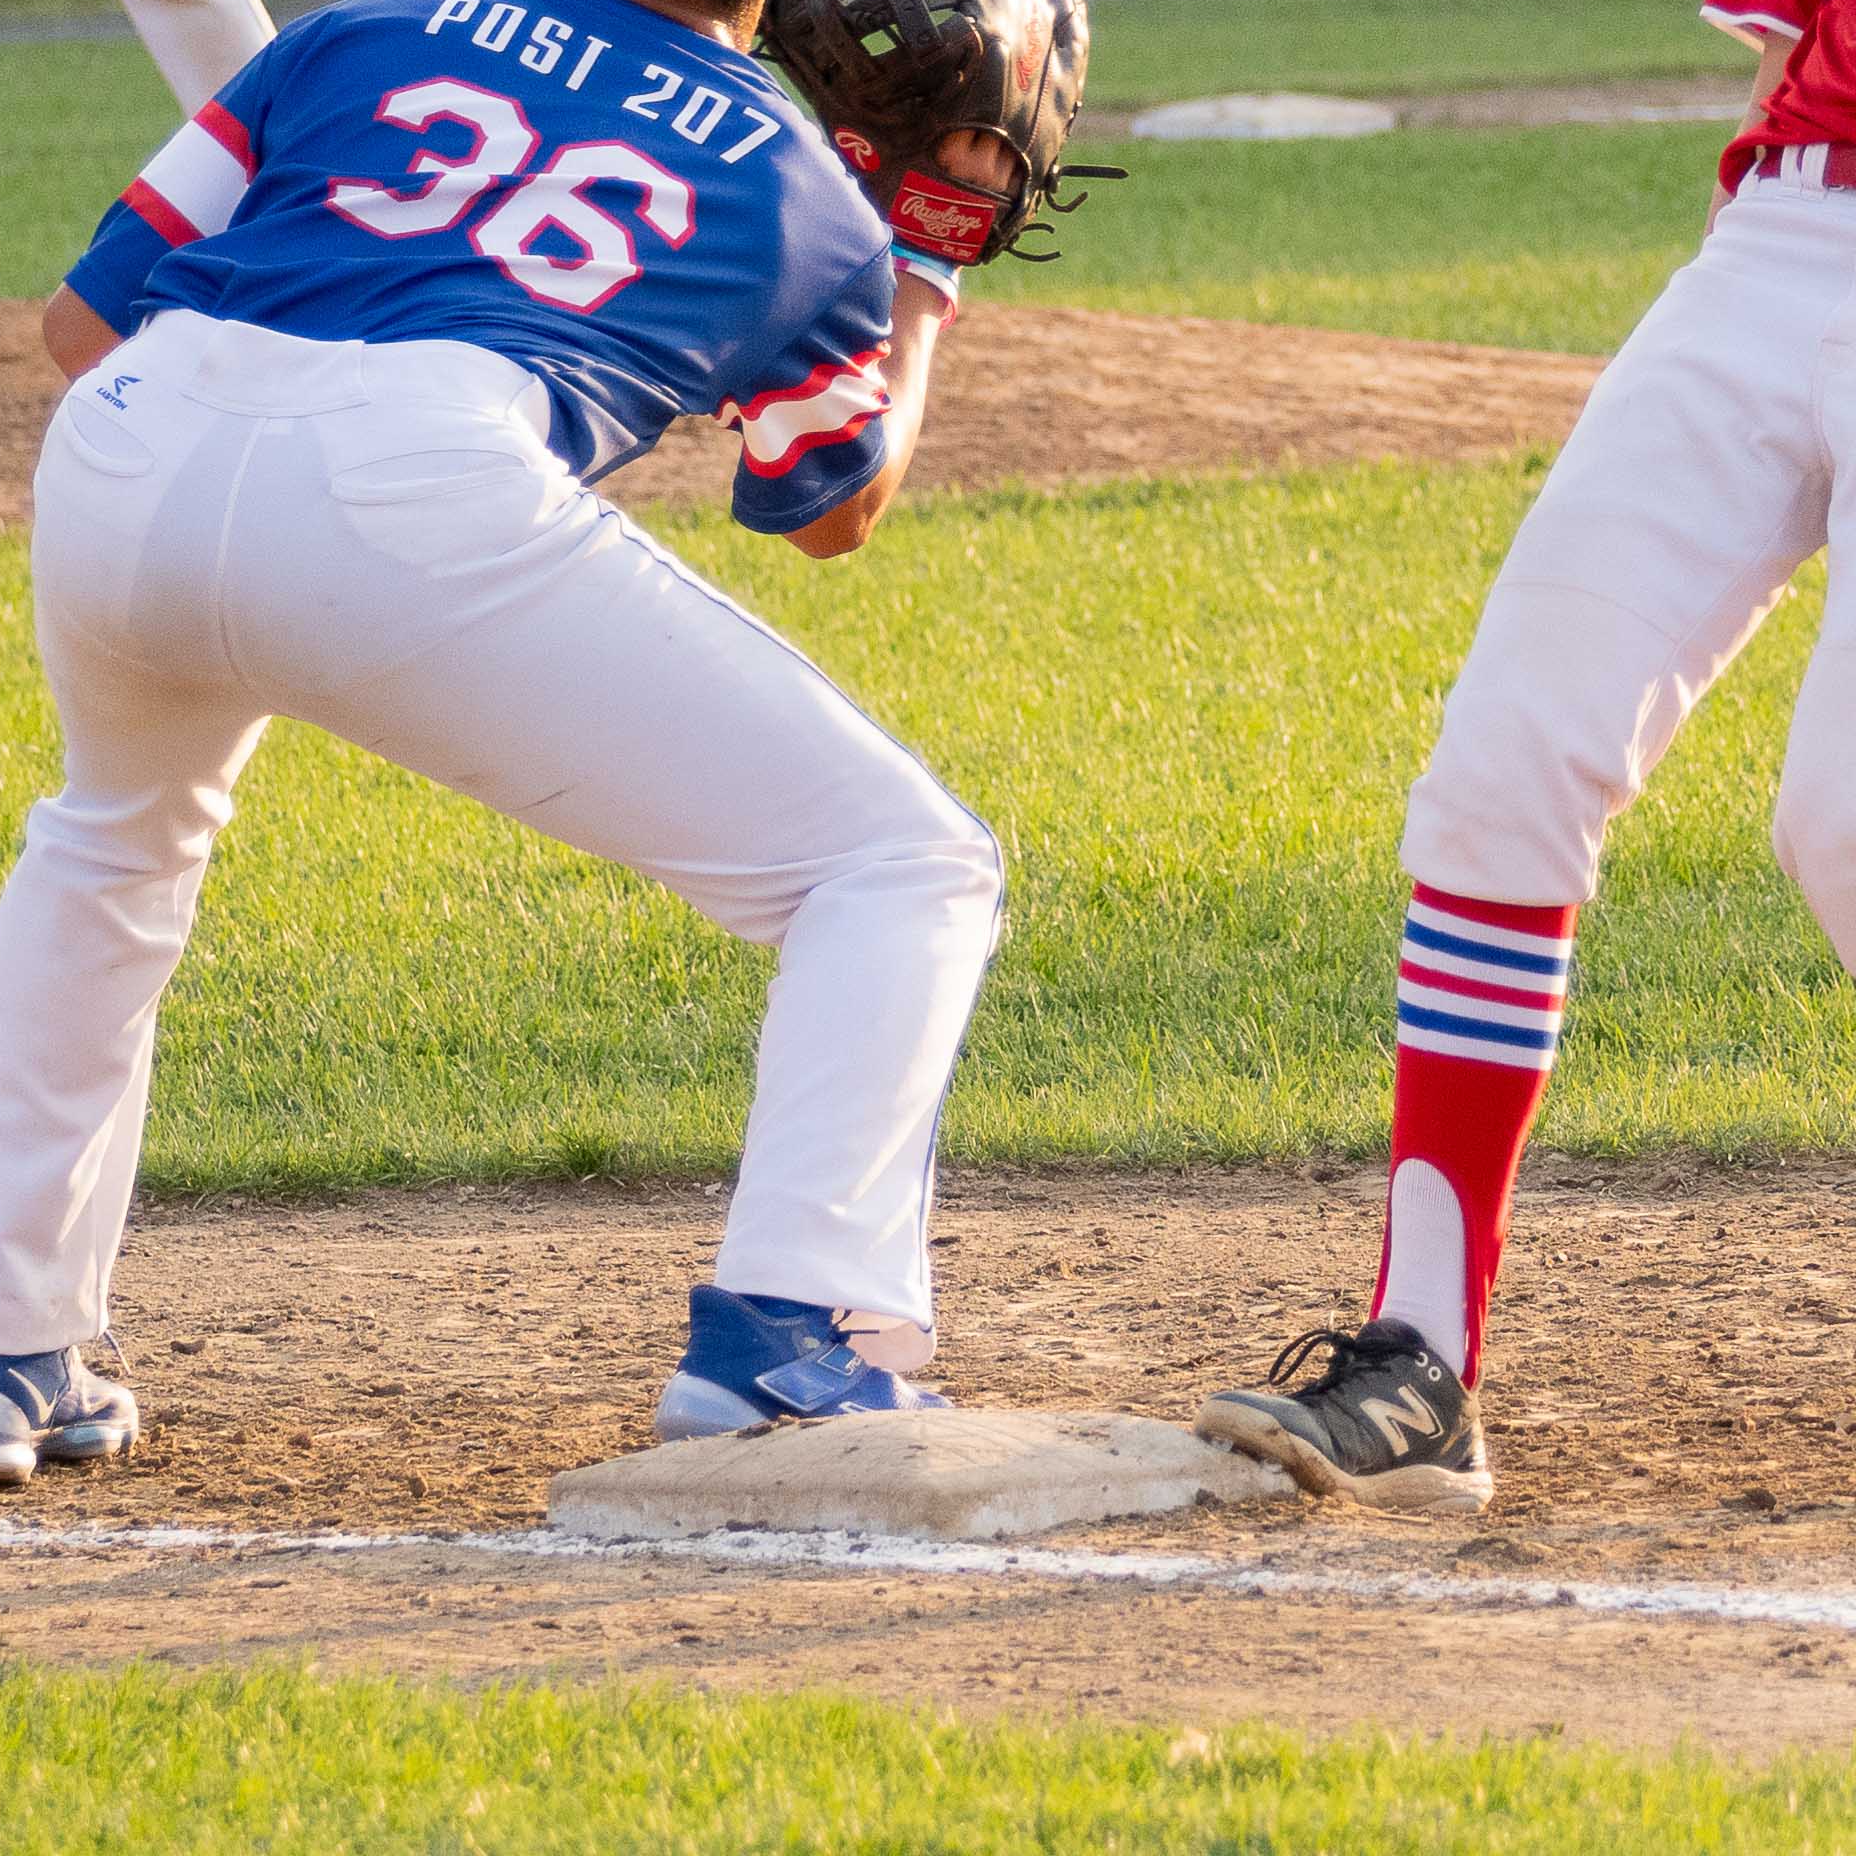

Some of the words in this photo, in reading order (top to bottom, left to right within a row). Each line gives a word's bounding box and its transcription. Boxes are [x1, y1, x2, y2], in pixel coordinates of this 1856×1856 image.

[621, 63, 782, 165] 207
[325, 76, 697, 315] 36
[900, 195, 983, 238] Rawlings
